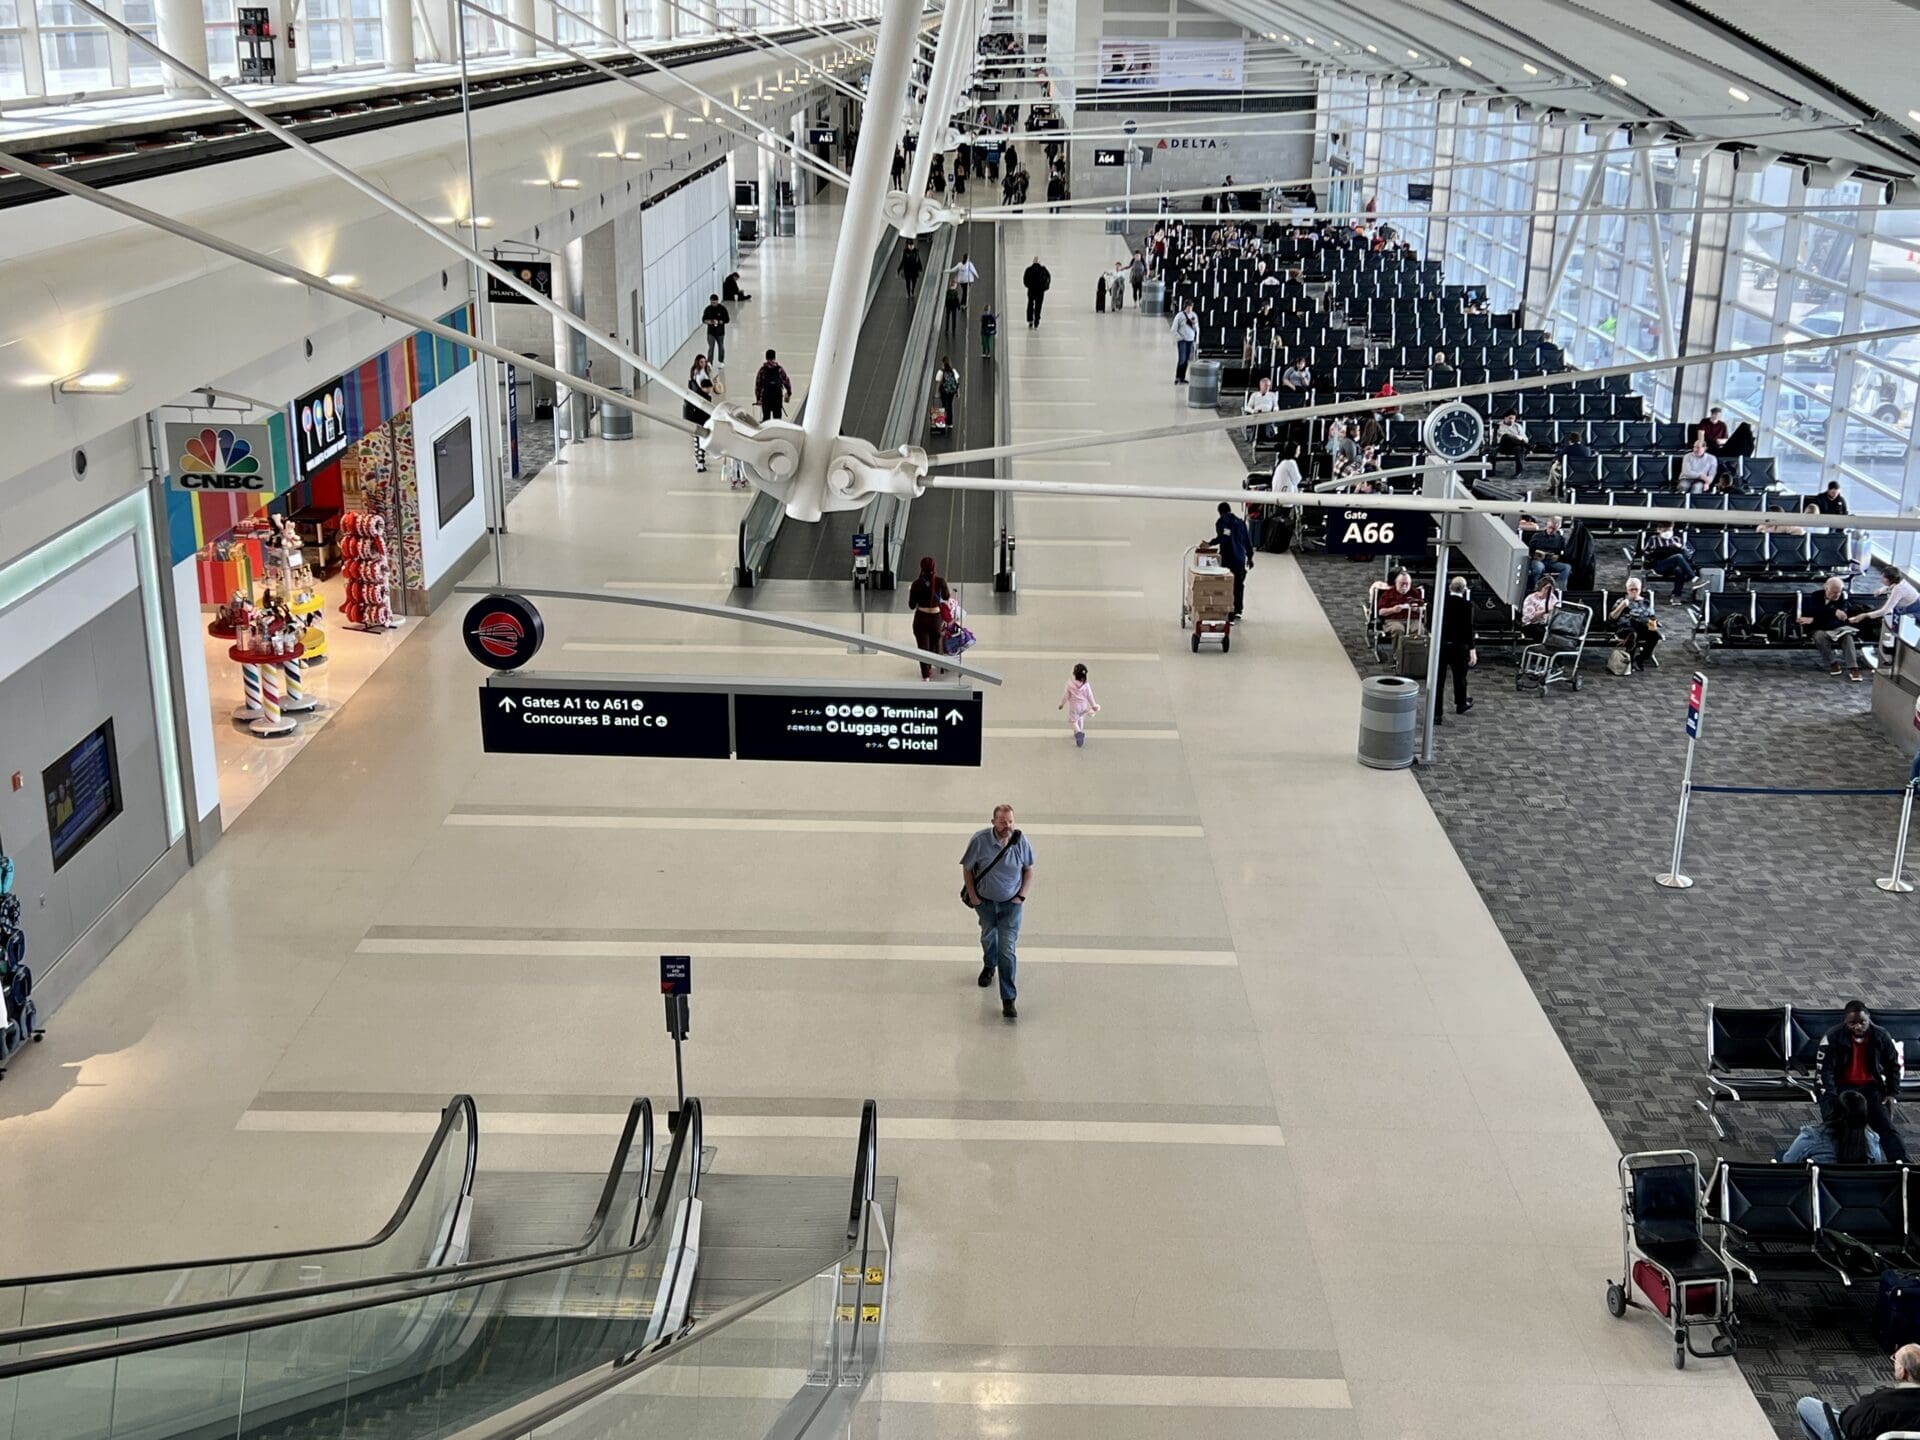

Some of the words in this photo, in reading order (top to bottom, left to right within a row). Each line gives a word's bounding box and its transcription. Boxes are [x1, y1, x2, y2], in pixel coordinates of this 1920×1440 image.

[1171, 139, 1217, 148] DELTA
[1098, 154, 1115, 163] A64
[180, 474, 264, 490] CNBC
[1344, 511, 1367, 520] Gate
[1342, 522, 1395, 543] A66
[522, 696, 560, 709] Gates
[563, 698, 581, 709] A1
[586, 698, 600, 710] to
[603, 699, 629, 710] A61
[881, 706, 938, 719] Terminal
[523, 712, 598, 726] Concourses
[602, 715, 611, 726] B
[614, 715, 639, 726] and
[643, 715, 653, 727] C
[840, 721, 898, 736] Luggage
[901, 723, 938, 735] Claim
[902, 739, 938, 750] Hotel
